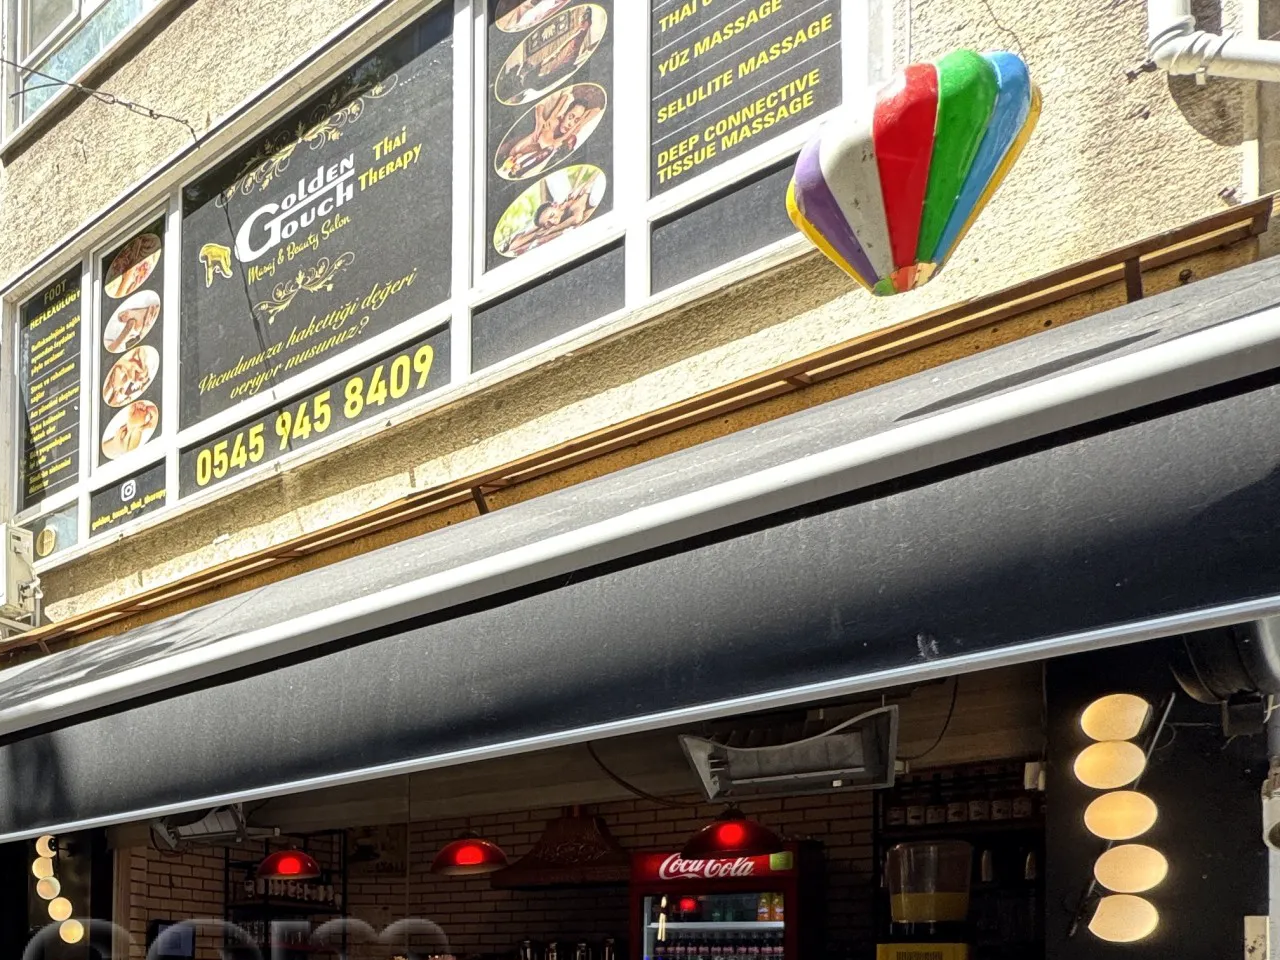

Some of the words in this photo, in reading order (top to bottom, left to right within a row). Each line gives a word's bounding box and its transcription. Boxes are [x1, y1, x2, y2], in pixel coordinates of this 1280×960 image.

[657, 47, 690, 78] YÜZ
[693, 0, 782, 58] MASSAGE
[657, 70, 733, 124] SELULITE
[738, 13, 832, 78] MASSAGE
[657, 134, 700, 168] DEEP
[704, 68, 821, 142] CONNECTIVE
[657, 143, 717, 184] TISSUE
[721, 90, 814, 151] MASSAGE
[287, 233, 319, 262] Beauty
[321, 213, 351, 241] Salon
[43, 278, 67, 305] FOOT
[286, 296, 359, 351] hakettiği
[361, 267, 418, 310] değeri
[230, 362, 283, 400] veriyor
[284, 316, 370, 372] musunuz?
[196, 422, 265, 487] 0545
[275, 390, 332, 451] 945
[343, 344, 434, 419] 8409
